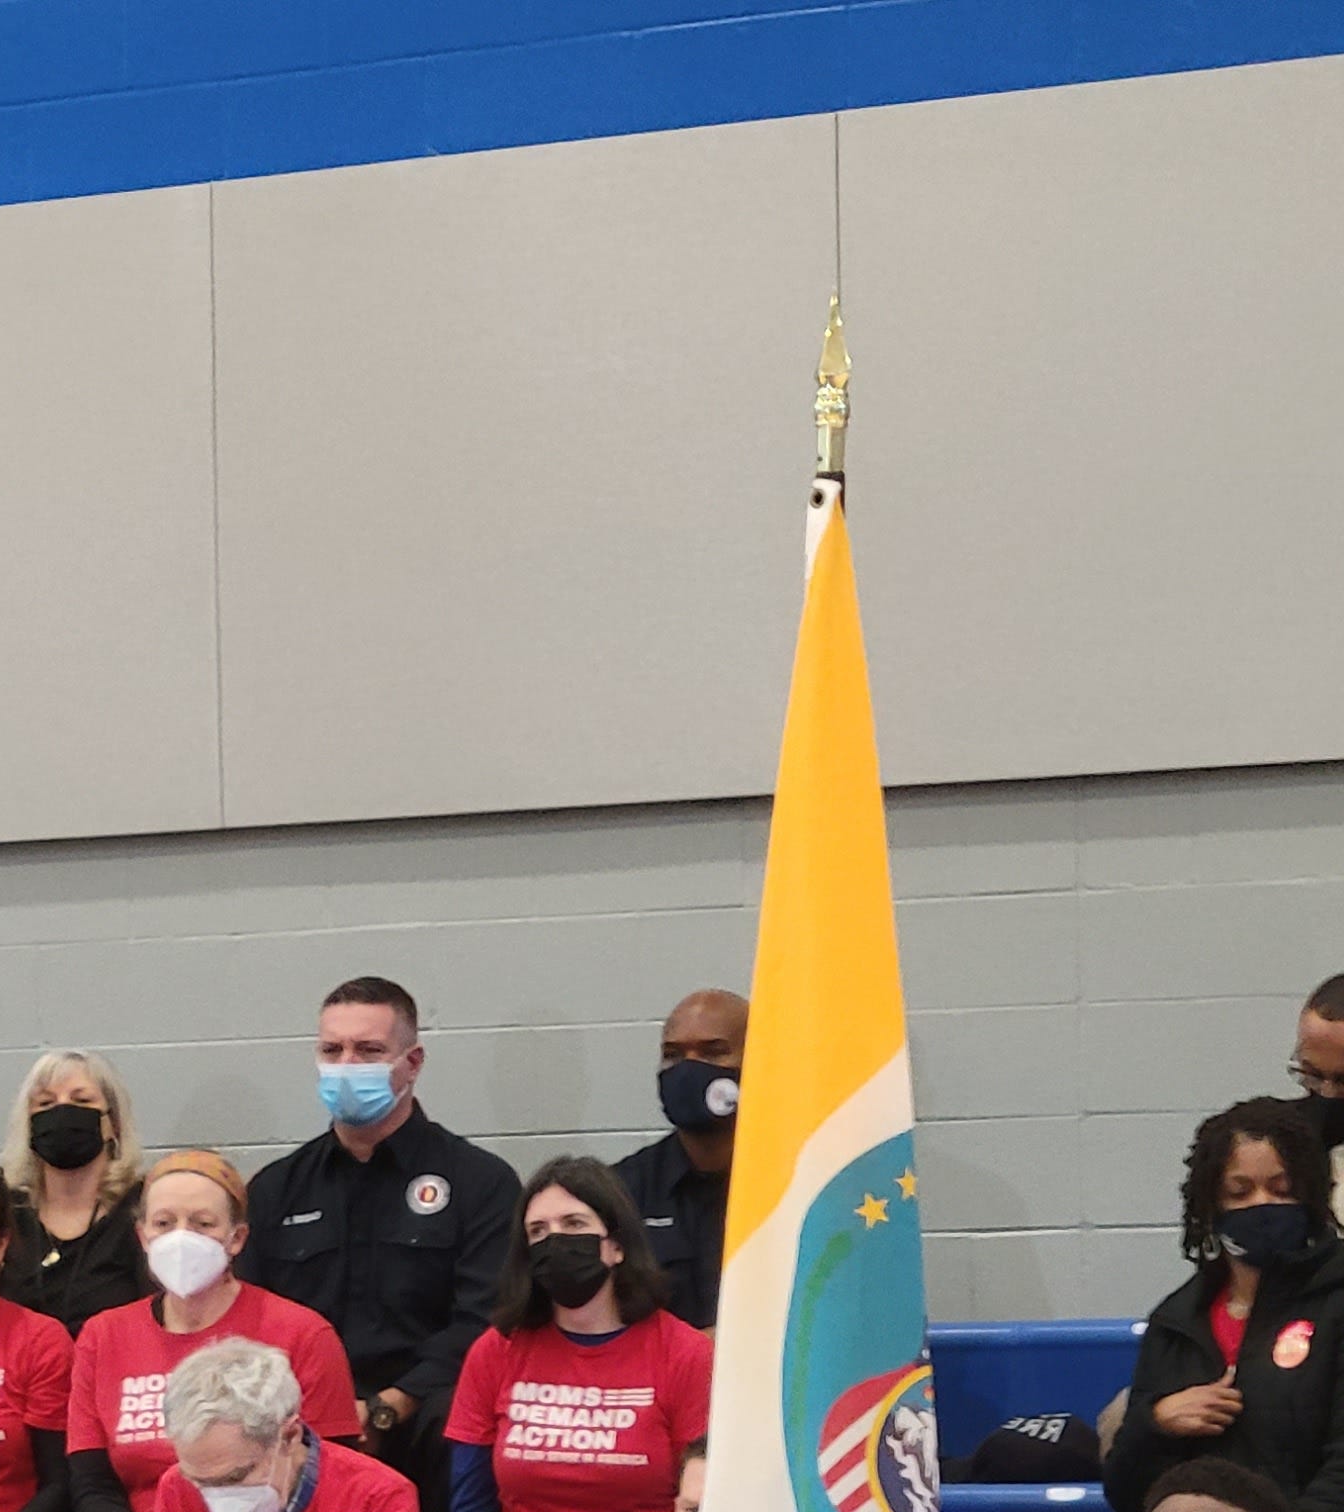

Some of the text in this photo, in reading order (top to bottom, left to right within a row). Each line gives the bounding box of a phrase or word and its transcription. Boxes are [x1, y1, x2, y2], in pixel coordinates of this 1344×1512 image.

[122, 1374, 169, 1394] MO
[512, 1381, 602, 1407] MOMS
[509, 1403, 637, 1429] DEMAND
[505, 1424, 618, 1450] ACTION
